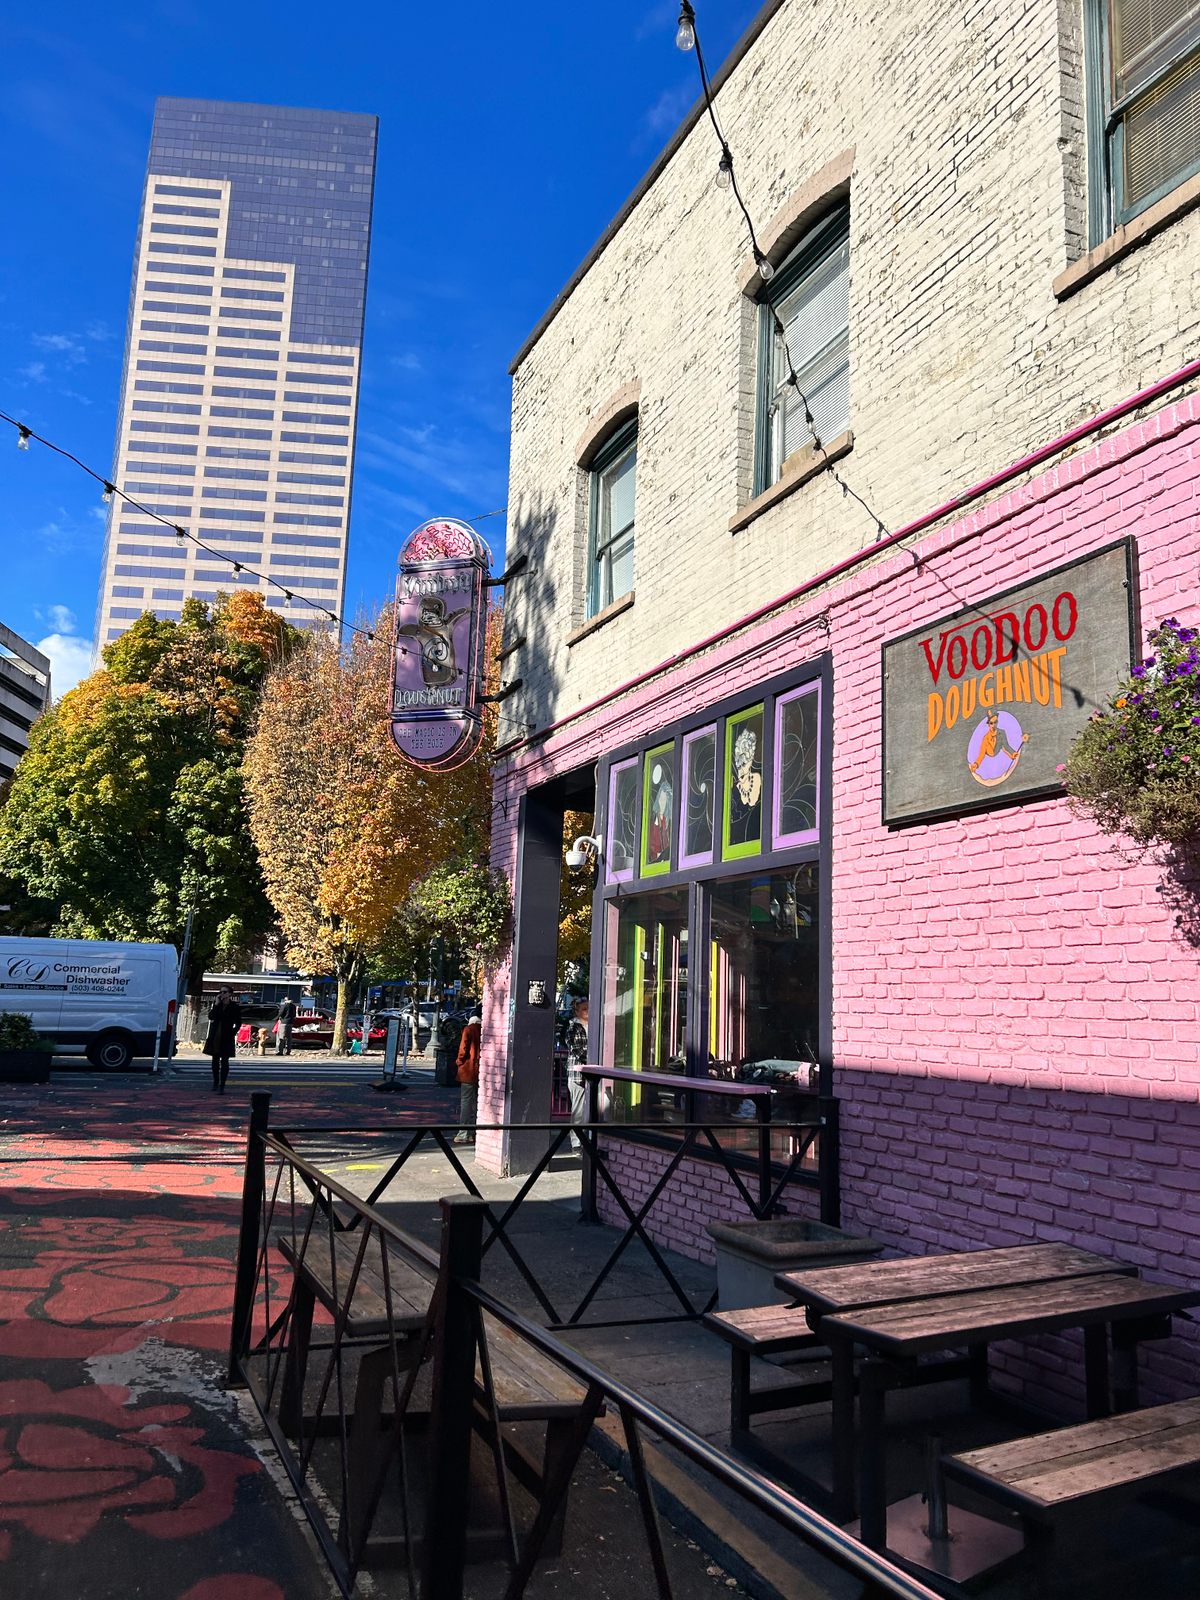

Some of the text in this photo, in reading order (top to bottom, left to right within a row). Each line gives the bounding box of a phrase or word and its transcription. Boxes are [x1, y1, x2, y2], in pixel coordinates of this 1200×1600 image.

[918, 591, 1078, 685] VOODOO
[927, 646, 1067, 743] DOUGHNUT
[53, 963, 121, 975] Commercial
[66, 974, 131, 986] Dishwasher
